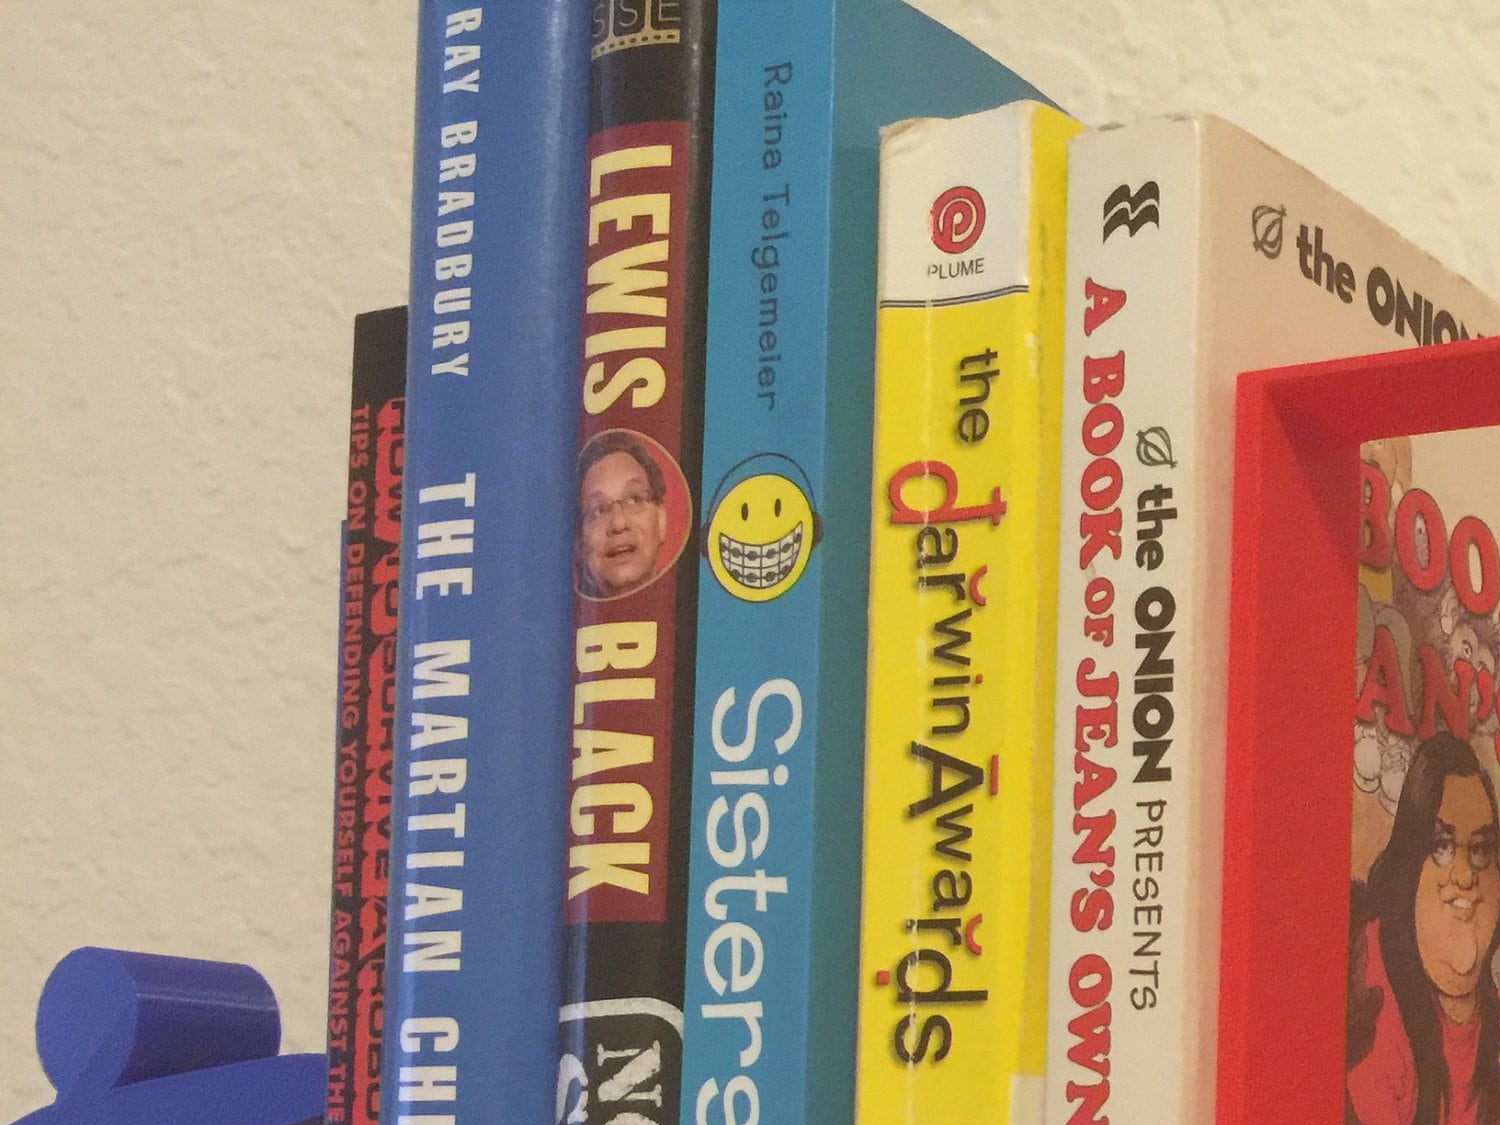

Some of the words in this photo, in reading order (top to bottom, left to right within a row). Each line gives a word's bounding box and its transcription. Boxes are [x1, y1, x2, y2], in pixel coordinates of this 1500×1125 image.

[443, 7, 482, 92] RAY
[761, 61, 793, 170] Raina
[431, 120, 478, 376] BRADBURY
[584, 145, 672, 416] LEWIS
[751, 190, 790, 412] Telgemeier
[926, 257, 985, 281] PLUME
[1082, 277, 1126, 336] A
[1296, 224, 1356, 304] the
[1367, 267, 1484, 347] ONIO
[350, 404, 369, 468] TIPS
[954, 348, 1000, 444] the
[1079, 351, 1125, 570] BOOK
[348, 481, 367, 530] ON
[416, 473, 475, 600] THE
[1136, 486, 1178, 570] the
[341, 543, 366, 730] DEFENDING
[1084, 577, 1115, 647] OF
[1133, 586, 1176, 783] ONION
[335, 740, 358, 898] YOURSELF
[403, 640, 470, 972] MARTIAN
[568, 622, 657, 900] BLACK
[1070, 659, 1119, 932] JEAN'S
[1129, 800, 1167, 1012] PRESENTS
[329, 909, 352, 1051] AGAINST
[327, 1063, 346, 1122] THE
